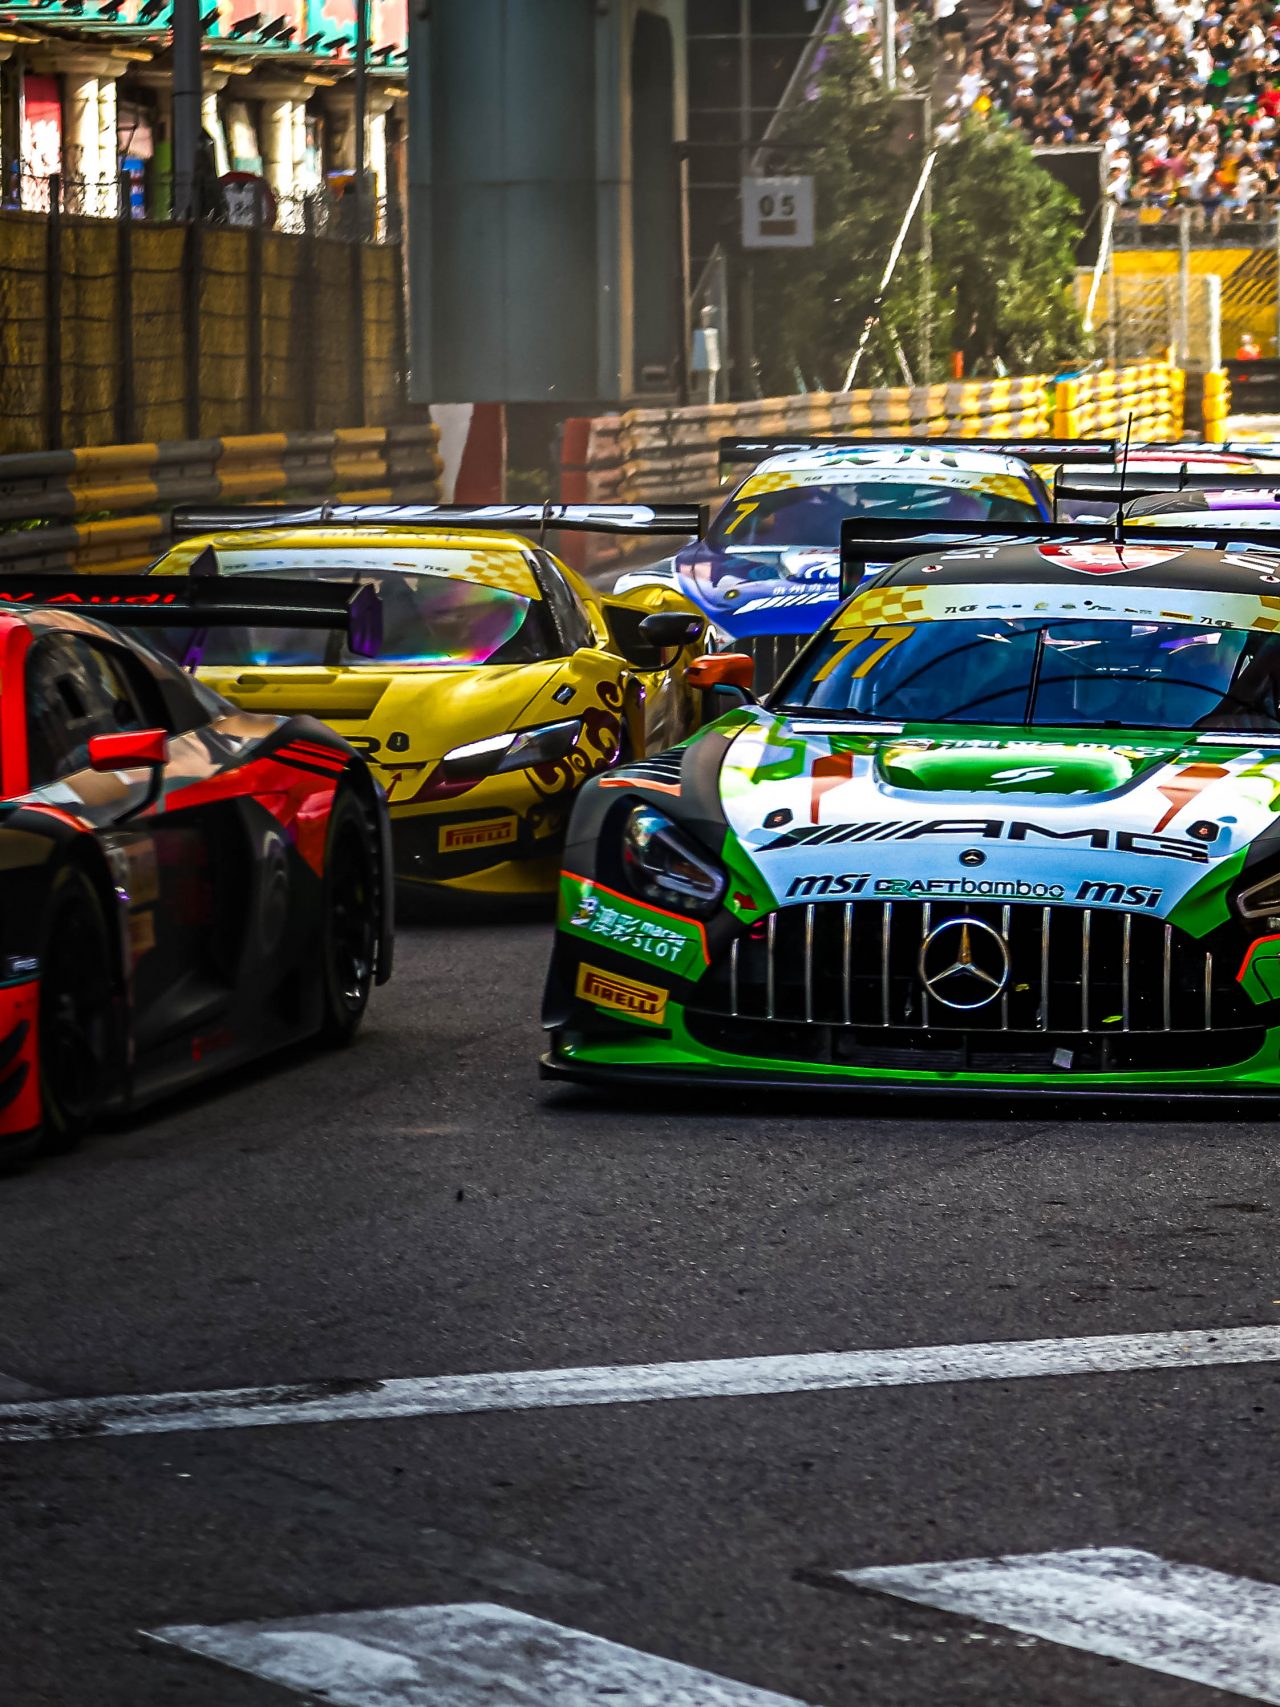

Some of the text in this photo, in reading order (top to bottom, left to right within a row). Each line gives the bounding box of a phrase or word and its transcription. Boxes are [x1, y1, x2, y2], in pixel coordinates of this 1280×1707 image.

[724, 502, 760, 535] 7
[812, 626, 917, 682] 77
[445, 821, 511, 847] PIRELLI
[895, 819, 1209, 864] AMG
[785, 873, 871, 898] msi
[1075, 877, 1164, 908] msi
[631, 936, 682, 962] SLOT
[583, 972, 660, 1015] PIRELLI
